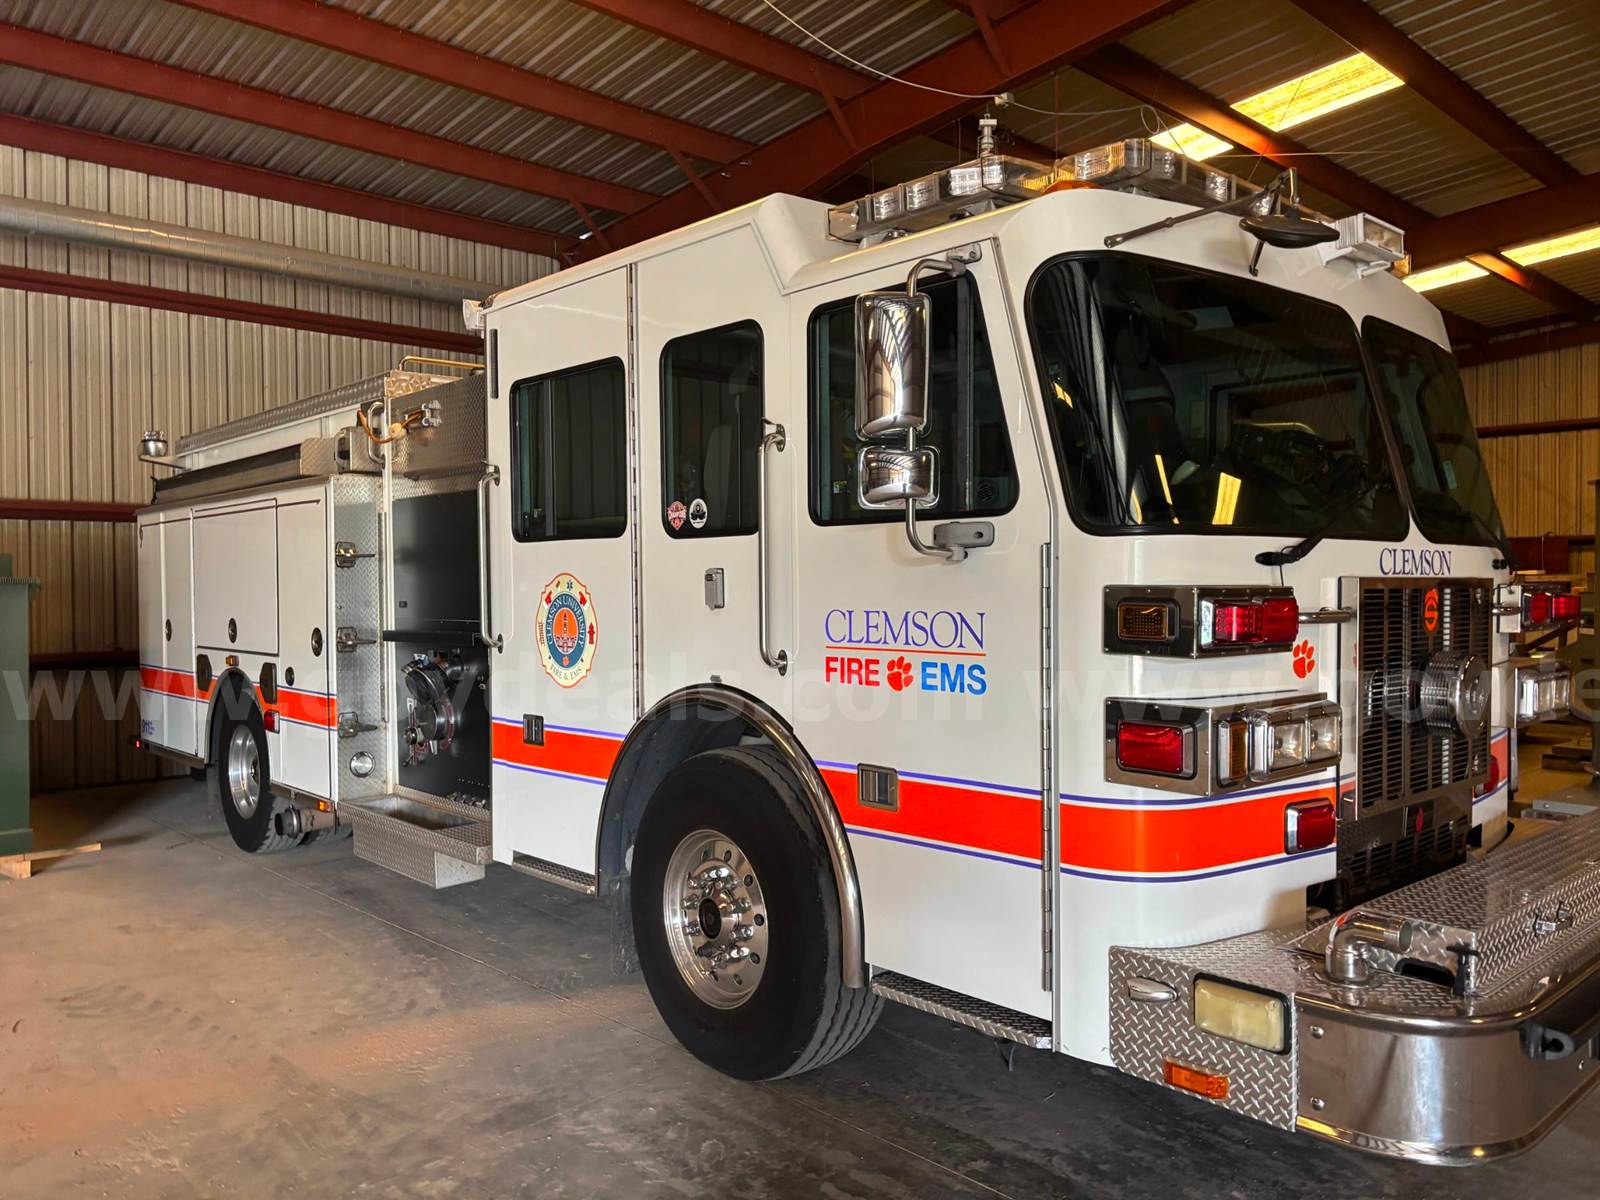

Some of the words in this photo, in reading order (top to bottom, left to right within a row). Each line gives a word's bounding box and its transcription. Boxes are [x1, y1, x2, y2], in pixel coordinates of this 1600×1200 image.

[1379, 547, 1452, 576] CLEMSON
[546, 597, 563, 646] CLEMSON
[562, 595, 586, 648] UNIVERSITY
[824, 608, 986, 650] CLEMSON
[549, 663, 563, 680] FIRE
[570, 666, 583, 680] EMS
[824, 655, 881, 687] FIRE
[920, 660, 988, 696] EMS
